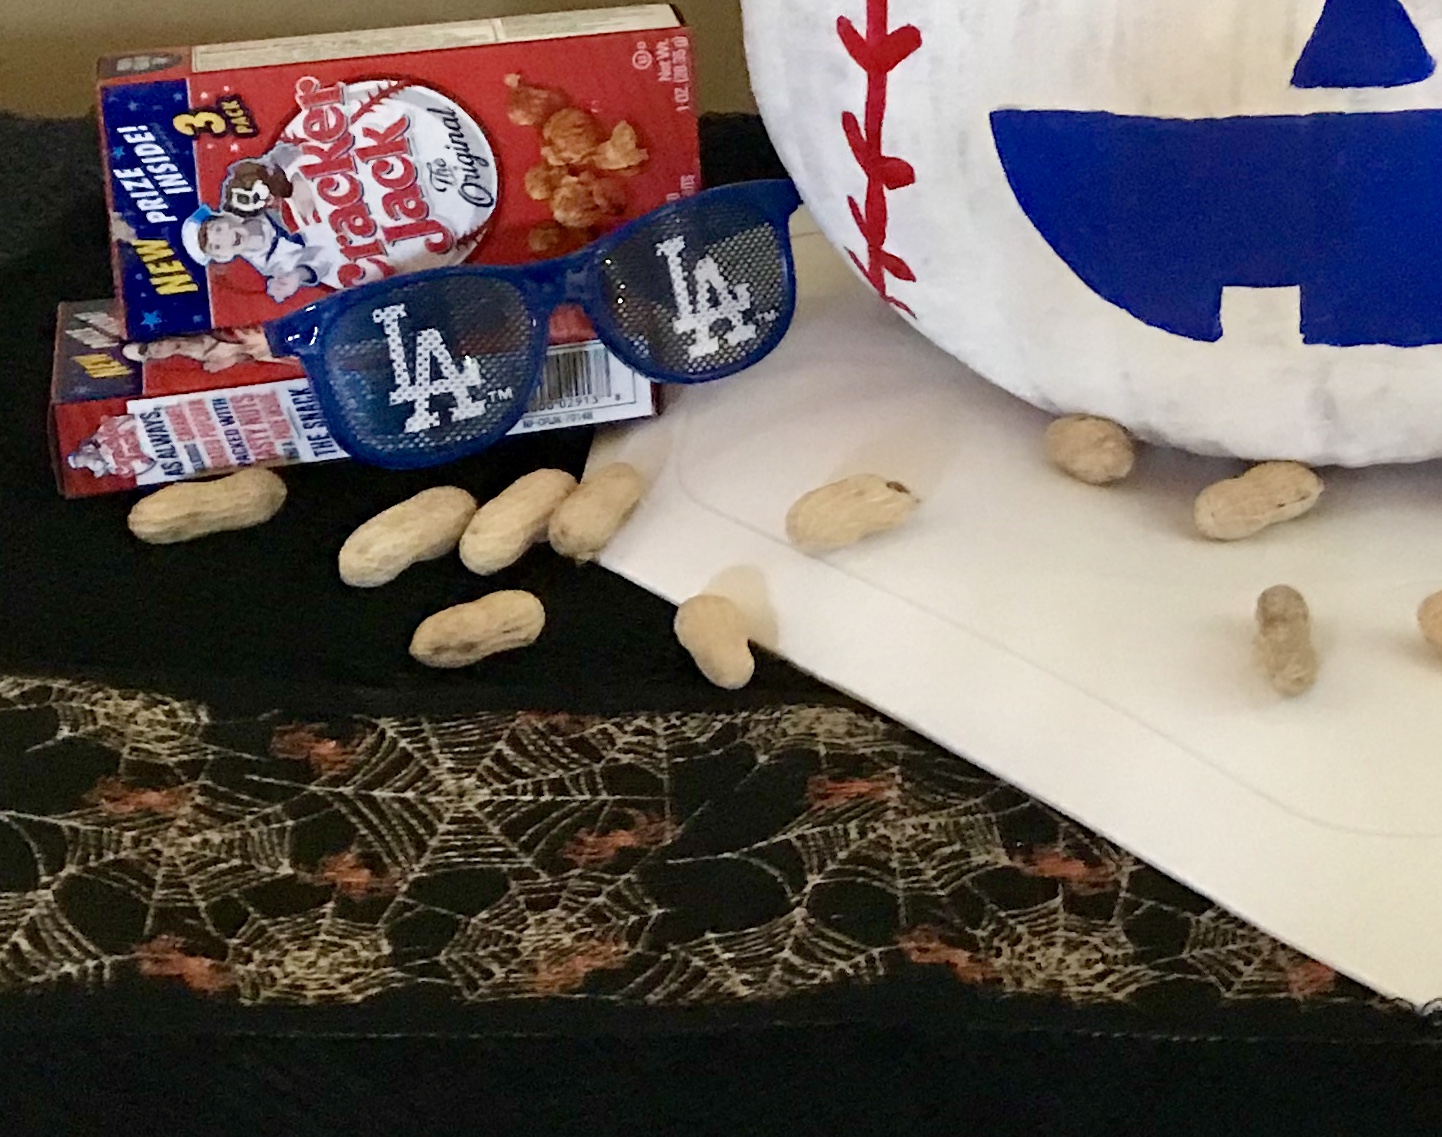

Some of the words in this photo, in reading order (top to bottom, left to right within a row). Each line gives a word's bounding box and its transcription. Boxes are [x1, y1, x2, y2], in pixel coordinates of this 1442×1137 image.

[172, 110, 226, 137] 3
[220, 98, 255, 135] PACK
[116, 125, 194, 194] INSIDE!
[295, 75, 396, 289] Cracker
[425, 157, 457, 194] The
[426, 106, 494, 209] Original
[113, 167, 178, 224] PRIZE
[355, 114, 451, 254] Jack
[131, 239, 199, 295] NEW
[656, 235, 758, 360] LA
[373, 303, 490, 433] LA
[211, 397, 236, 428] WITH
[287, 388, 323, 432] SNACK
[487, 386, 514, 402] TM
[160, 460, 186, 477] AS
[306, 433, 338, 459] THE
